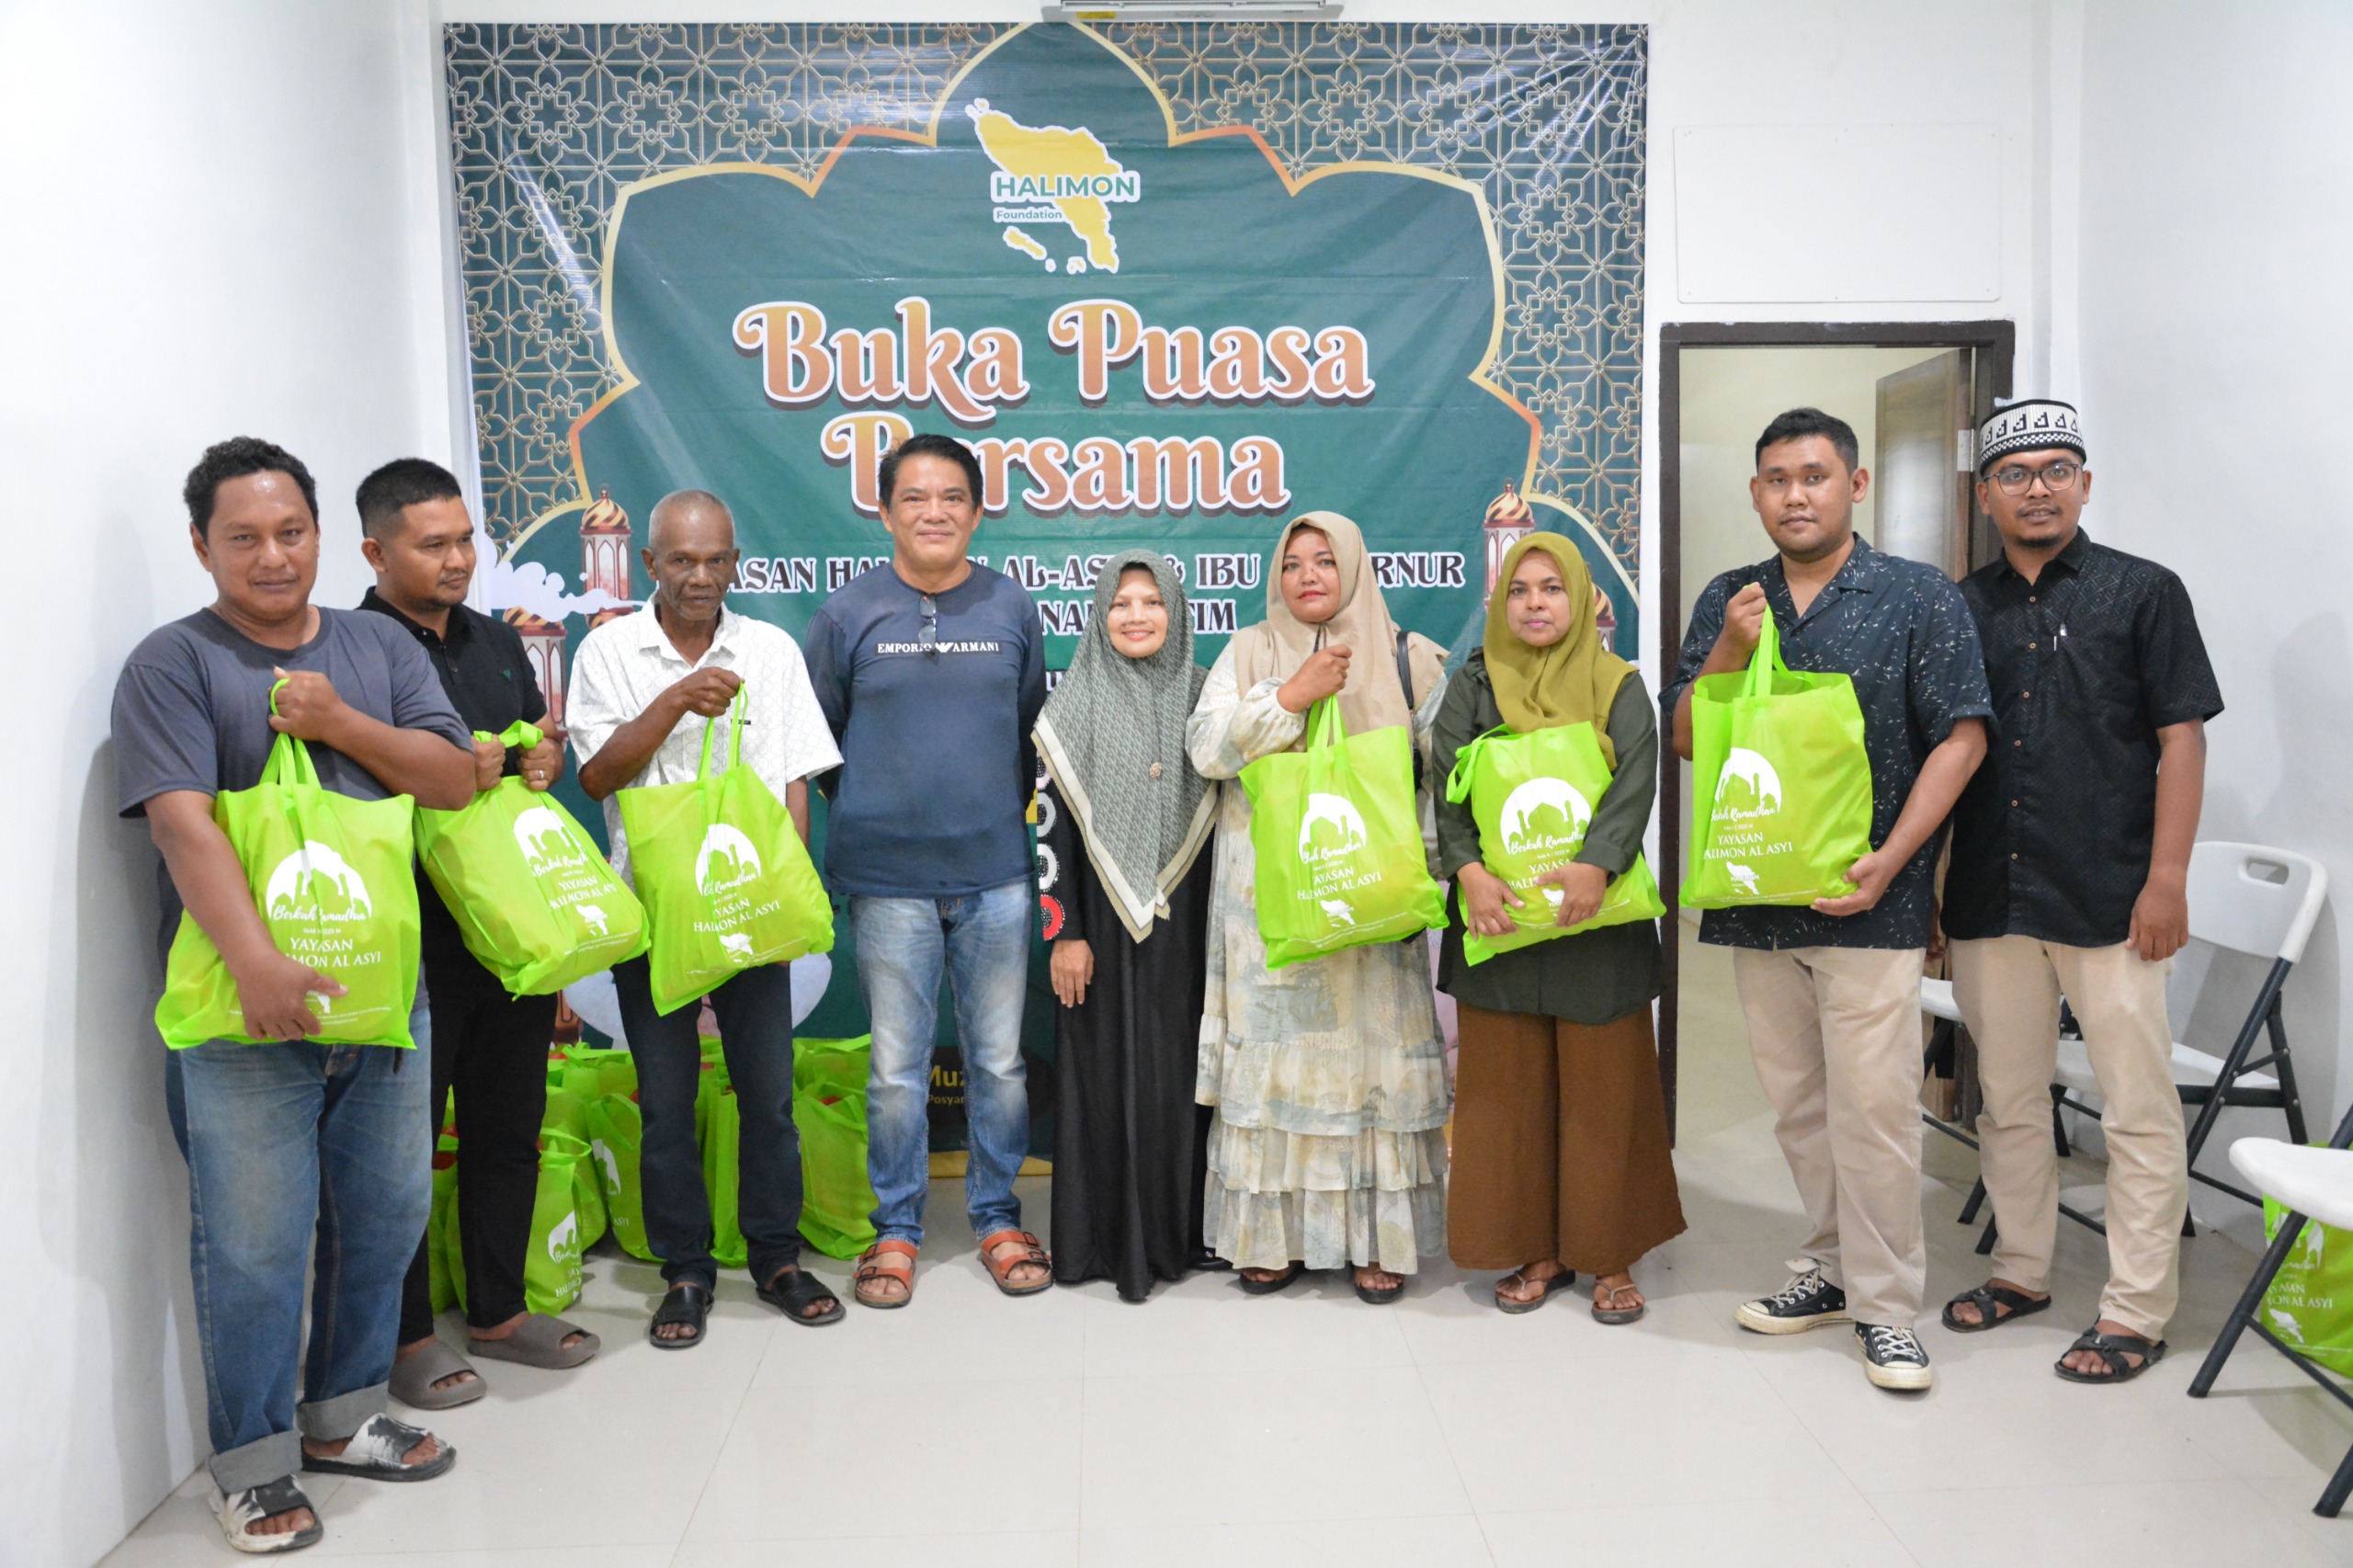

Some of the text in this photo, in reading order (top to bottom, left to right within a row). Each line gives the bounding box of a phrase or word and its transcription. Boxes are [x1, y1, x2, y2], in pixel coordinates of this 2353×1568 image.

[995, 176, 1135, 198] HALIMON
[995, 210, 1063, 220] Foundation
[733, 296, 1376, 422] Buka Puasa
[821, 411, 1291, 512] Brsama
[1196, 554, 1260, 591] IBU
[877, 642, 999, 653] EMPORIO ARMANI
[1718, 832, 1763, 846] YAYASAN
[1704, 841, 1793, 859] ALIMON AL ASYI
[1529, 858, 1571, 874] YAYASA
[1313, 866, 1354, 885] AYASAN
[1341, 880, 1356, 891] AL
[1357, 870, 1382, 887] ASYI
[274, 903, 317, 921] Berkah
[739, 911, 754, 924] AL
[756, 899, 781, 917] ASYI
[332, 955, 349, 967] AL
[353, 950, 381, 966] ASYI
[2307, 1298, 2333, 1309] ASYI
